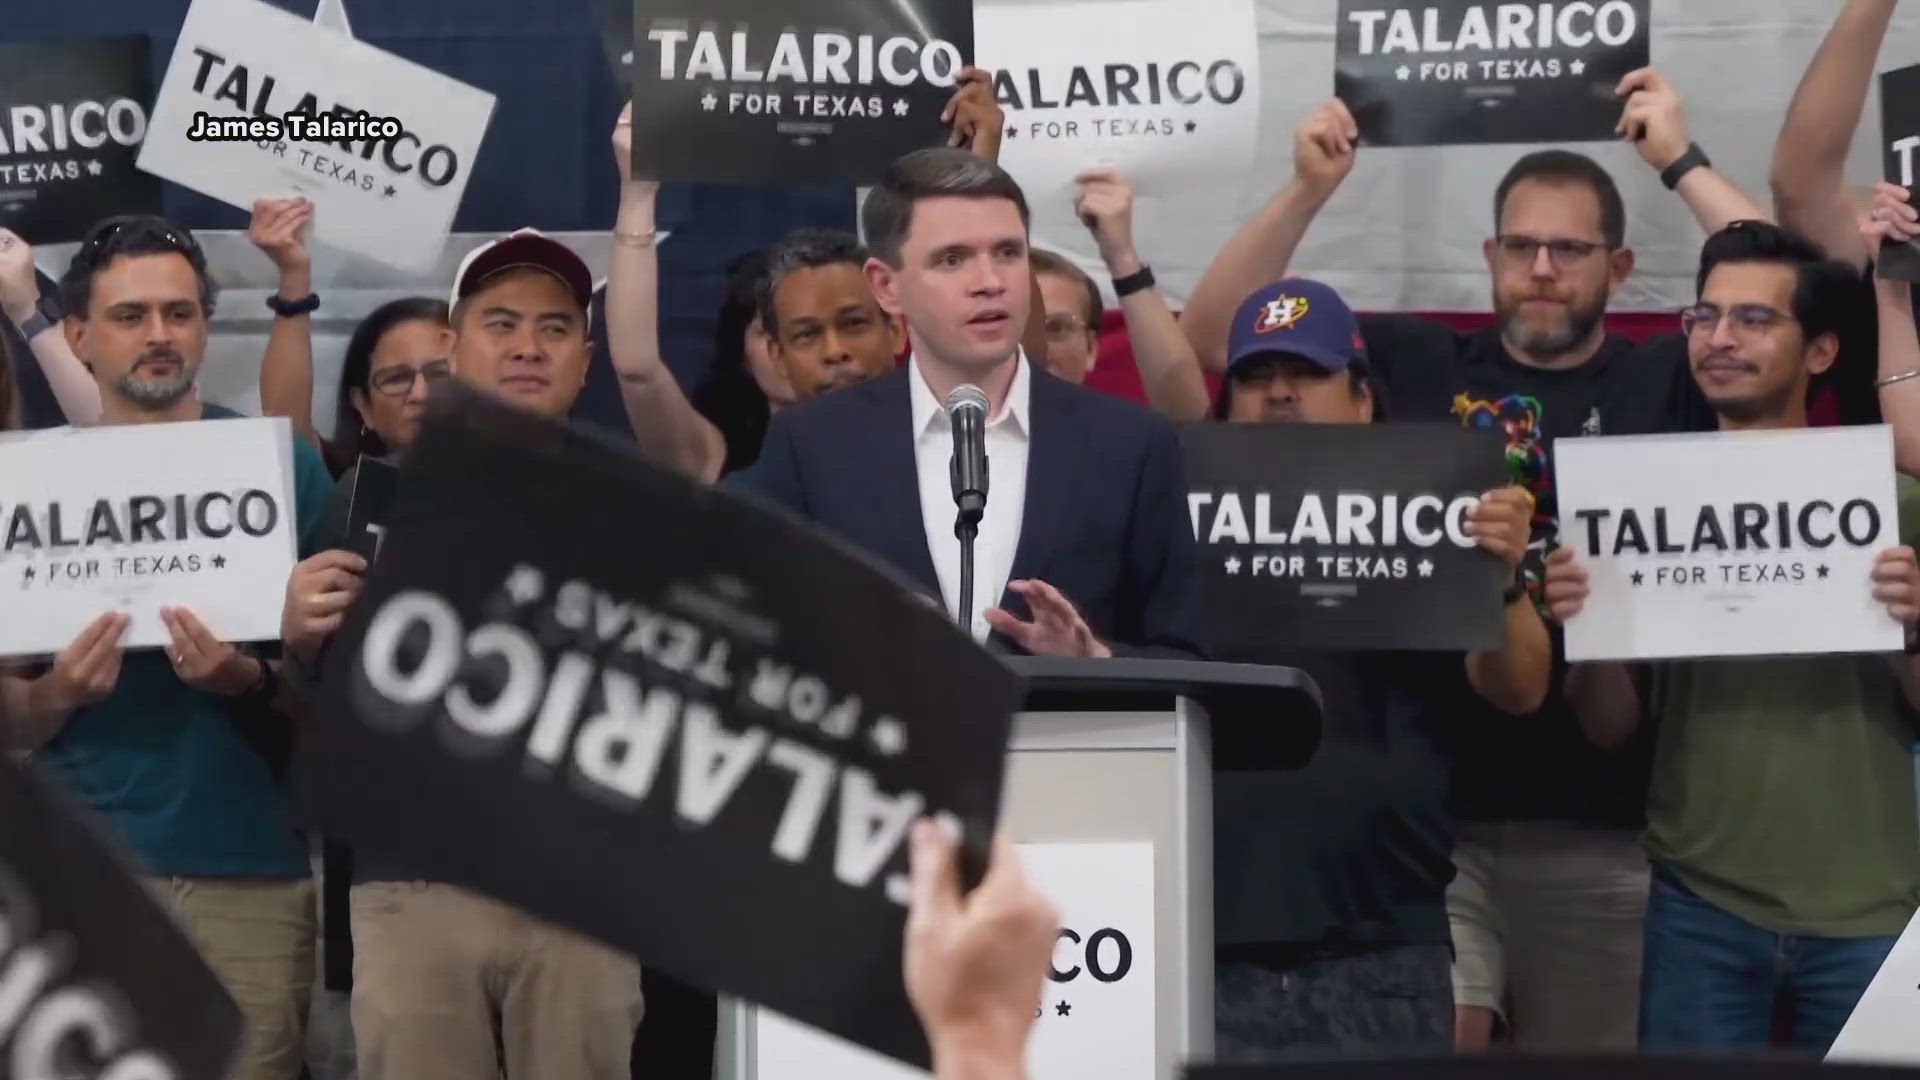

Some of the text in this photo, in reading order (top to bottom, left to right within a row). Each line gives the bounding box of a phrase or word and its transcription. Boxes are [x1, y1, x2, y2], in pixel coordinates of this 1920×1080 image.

[1348, 1, 1637, 55] TALARICO
[648, 29, 963, 88] TALARICO
[1420, 58, 1561, 81] FOR TEXAS
[729, 92, 883, 118] FOR TEXAS
[993, 59, 1245, 110] ALARICO
[0, 98, 147, 155] RICO
[1031, 119, 1173, 138] FOR TEXAS
[0, 160, 80, 184] TEXAS
[256, 139, 288, 158] OR
[299, 148, 375, 191] TEXAS
[3, 488, 278, 551] ALARICO
[1575, 498, 1881, 557] TALARICO
[49, 554, 202, 581] FOR TEXAS
[1252, 556, 1408, 579] FOR TEXAS
[1656, 562, 1805, 586] FOR TEXAS
[553, 578, 734, 690] TEXAS
[362, 589, 963, 905] ALARICO
